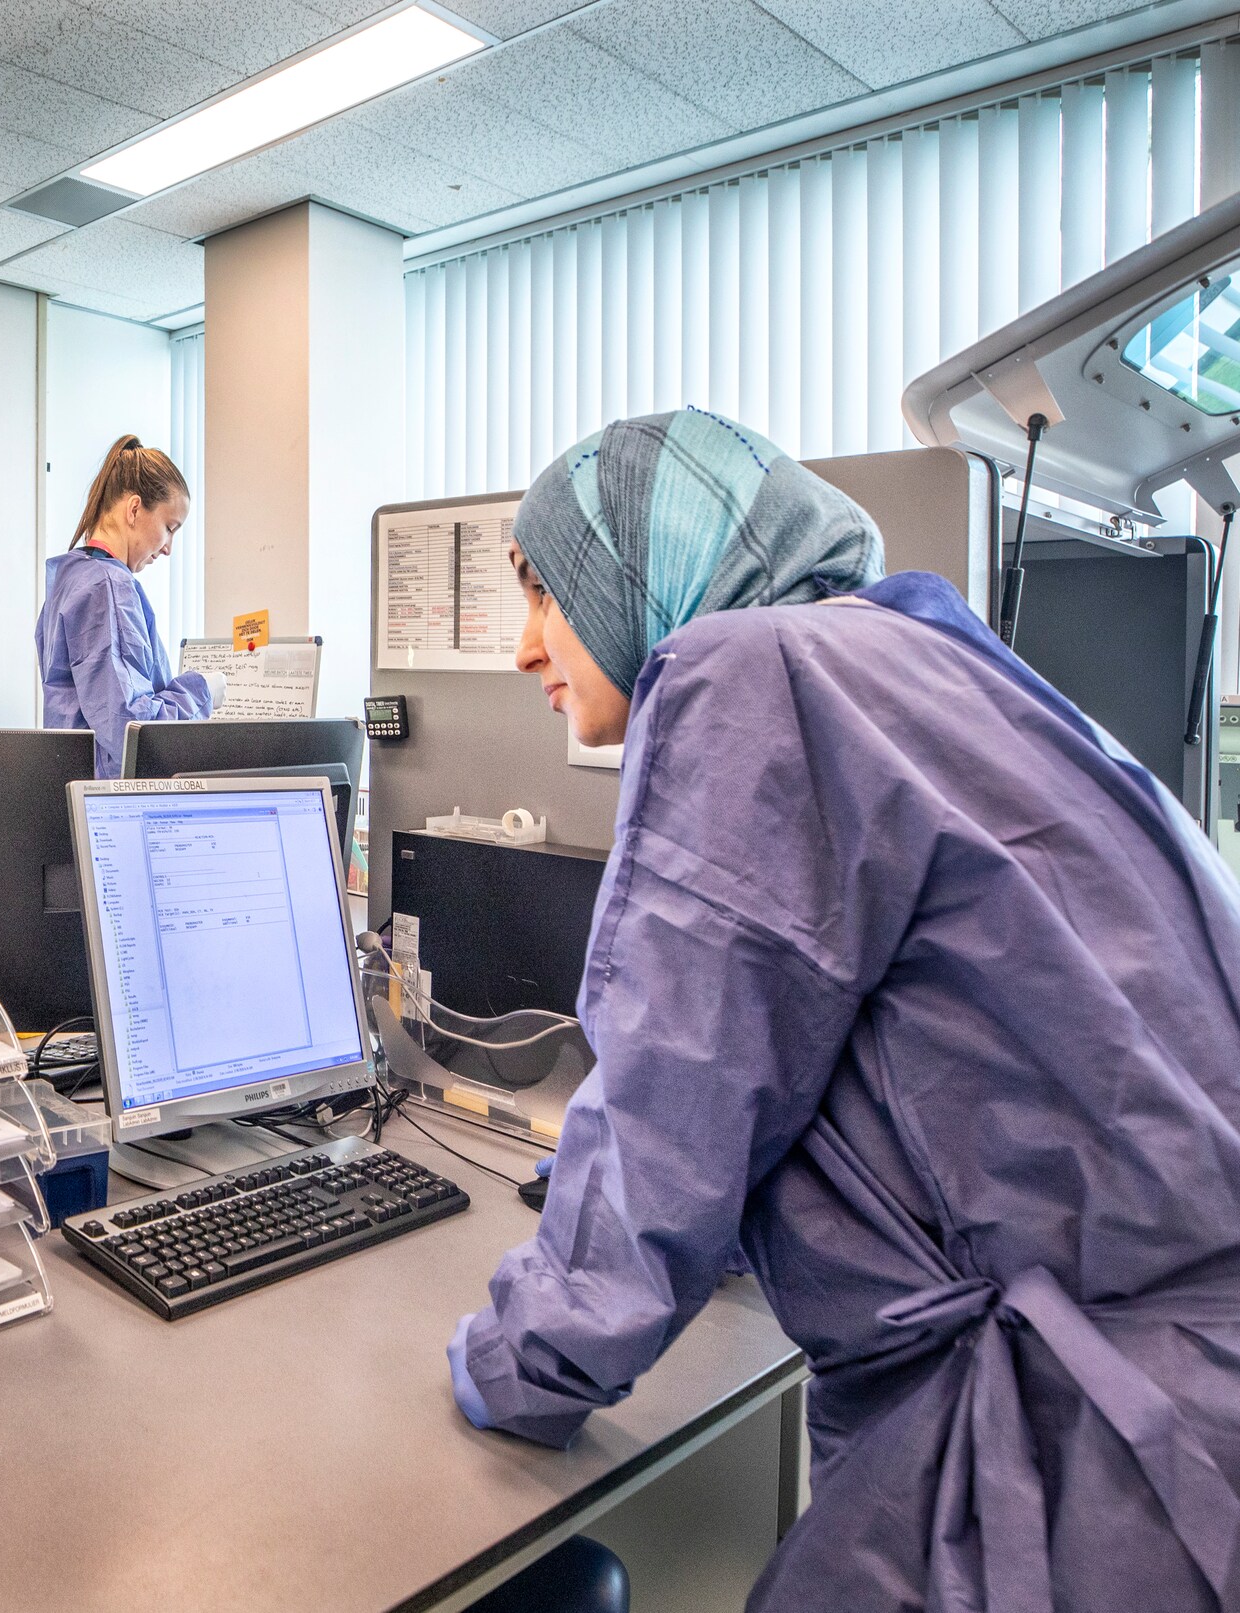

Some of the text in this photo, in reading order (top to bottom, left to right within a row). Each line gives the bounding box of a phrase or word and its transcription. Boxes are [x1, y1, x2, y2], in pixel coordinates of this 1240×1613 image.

[113, 780, 205, 792] SERVER FLOW GLOBAL
[244, 1090, 270, 1102] PHILIPS
[0, 1299, 40, 1317] MELDFORMULIER
